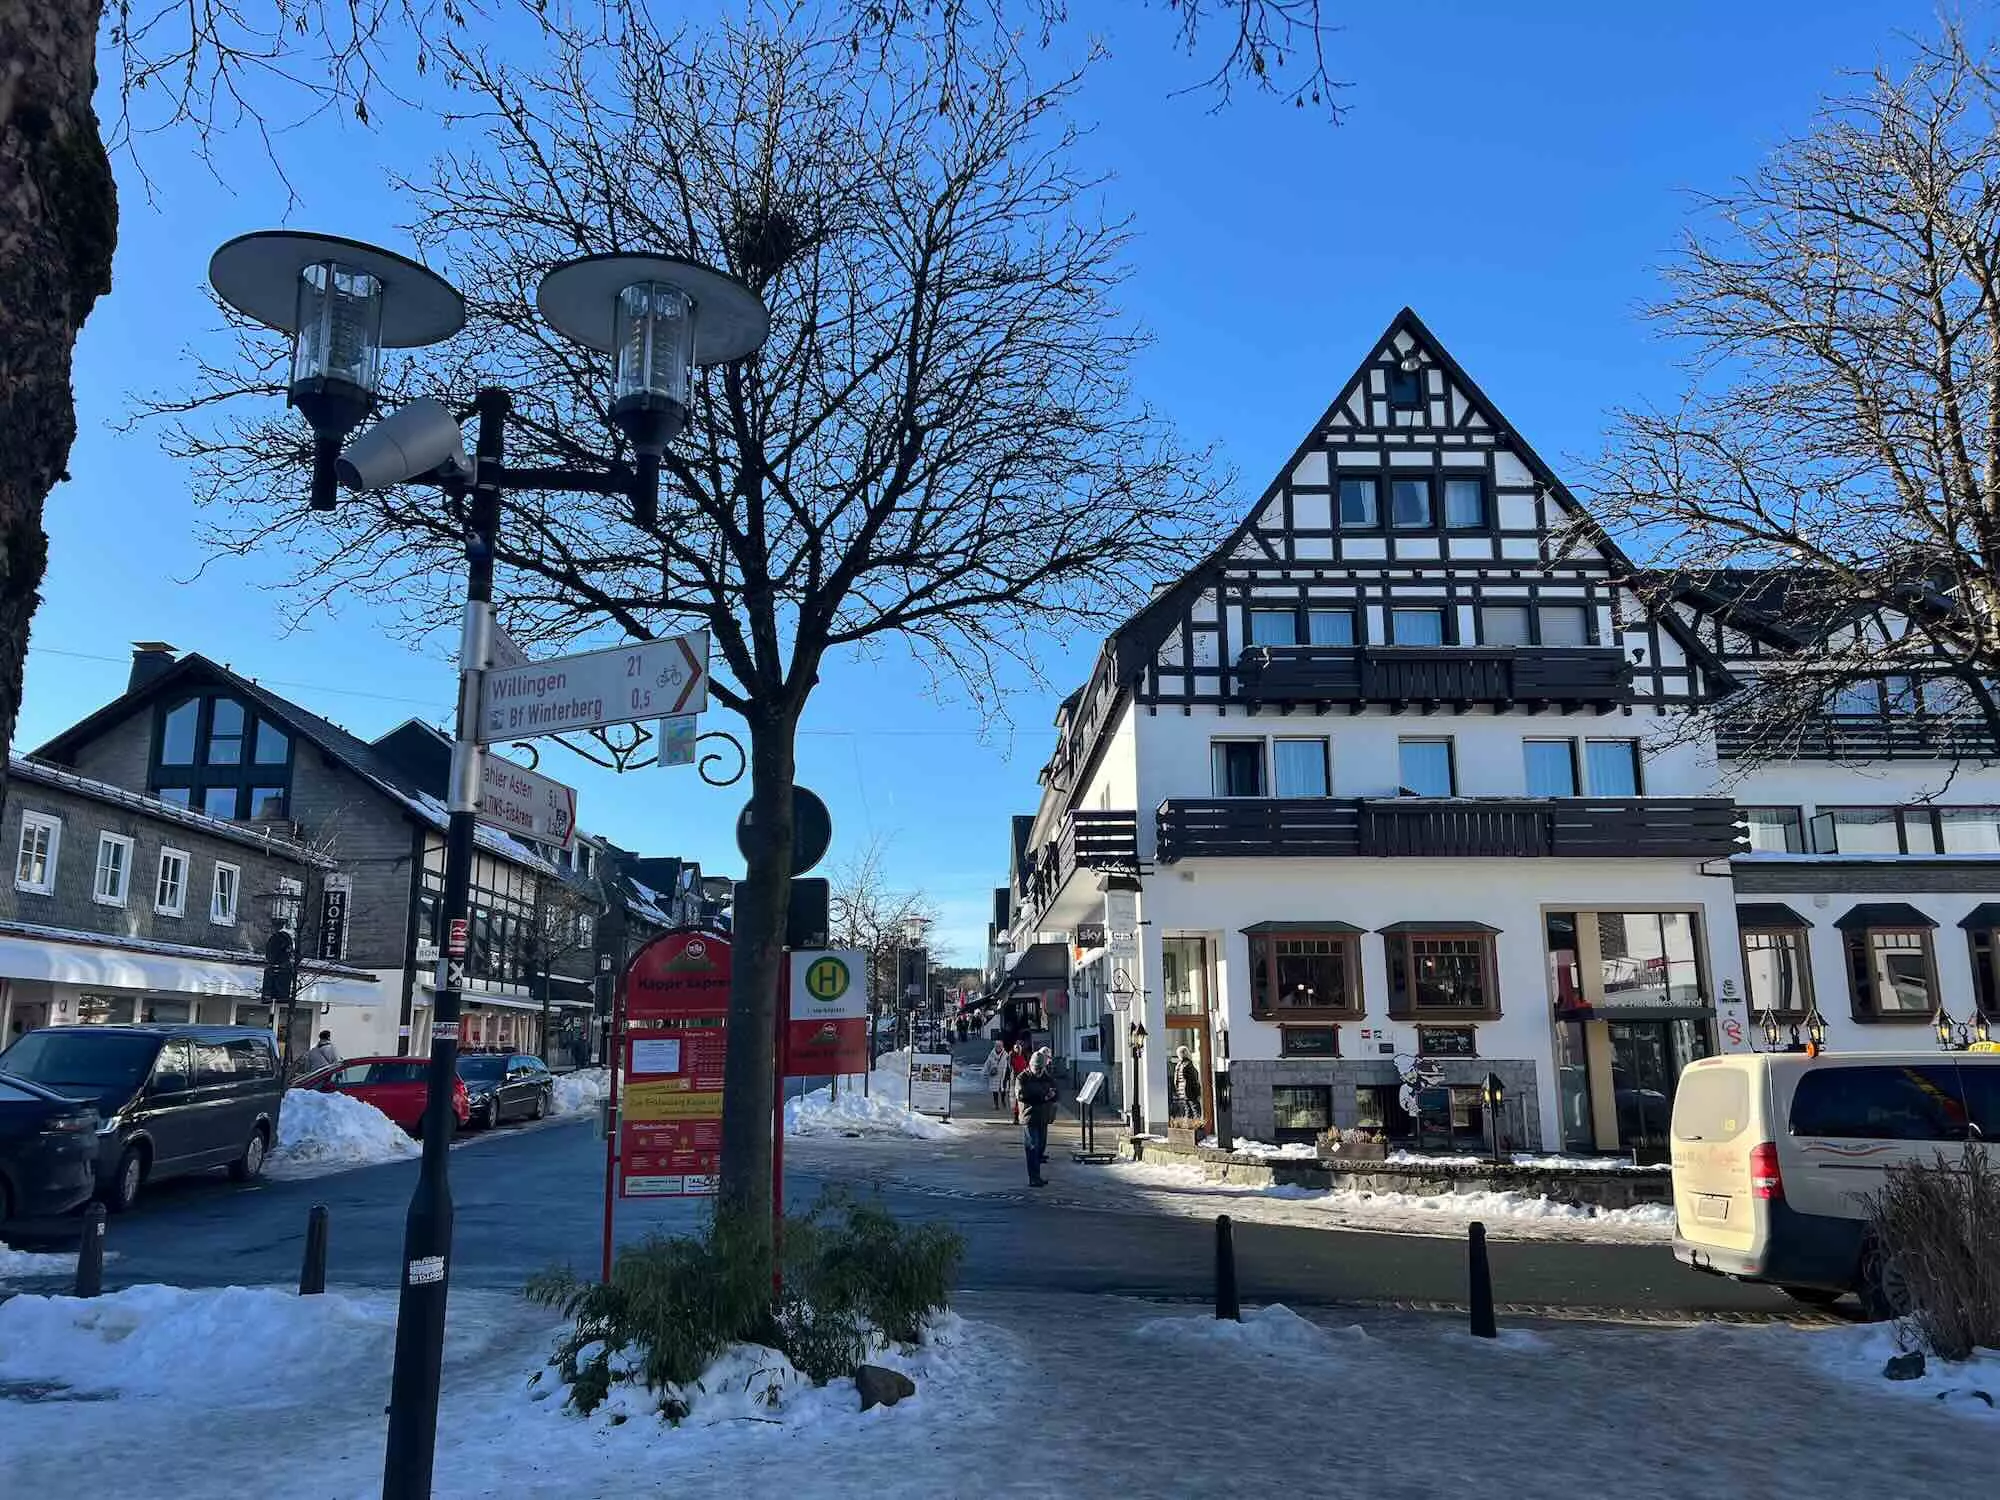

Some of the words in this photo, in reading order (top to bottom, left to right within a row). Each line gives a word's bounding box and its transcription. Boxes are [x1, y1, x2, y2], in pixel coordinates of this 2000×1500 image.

[492, 672, 567, 699] Willingen
[627, 655, 642, 677] 21
[528, 697, 603, 725] Winterberg
[631, 687, 651, 711] 0,5
[484, 764, 507, 788] ahler
[510, 775, 534, 800] Asten
[326, 893, 340, 958] HOTEL
[1080, 928, 1102, 943] sky
[819, 966, 836, 992] H
